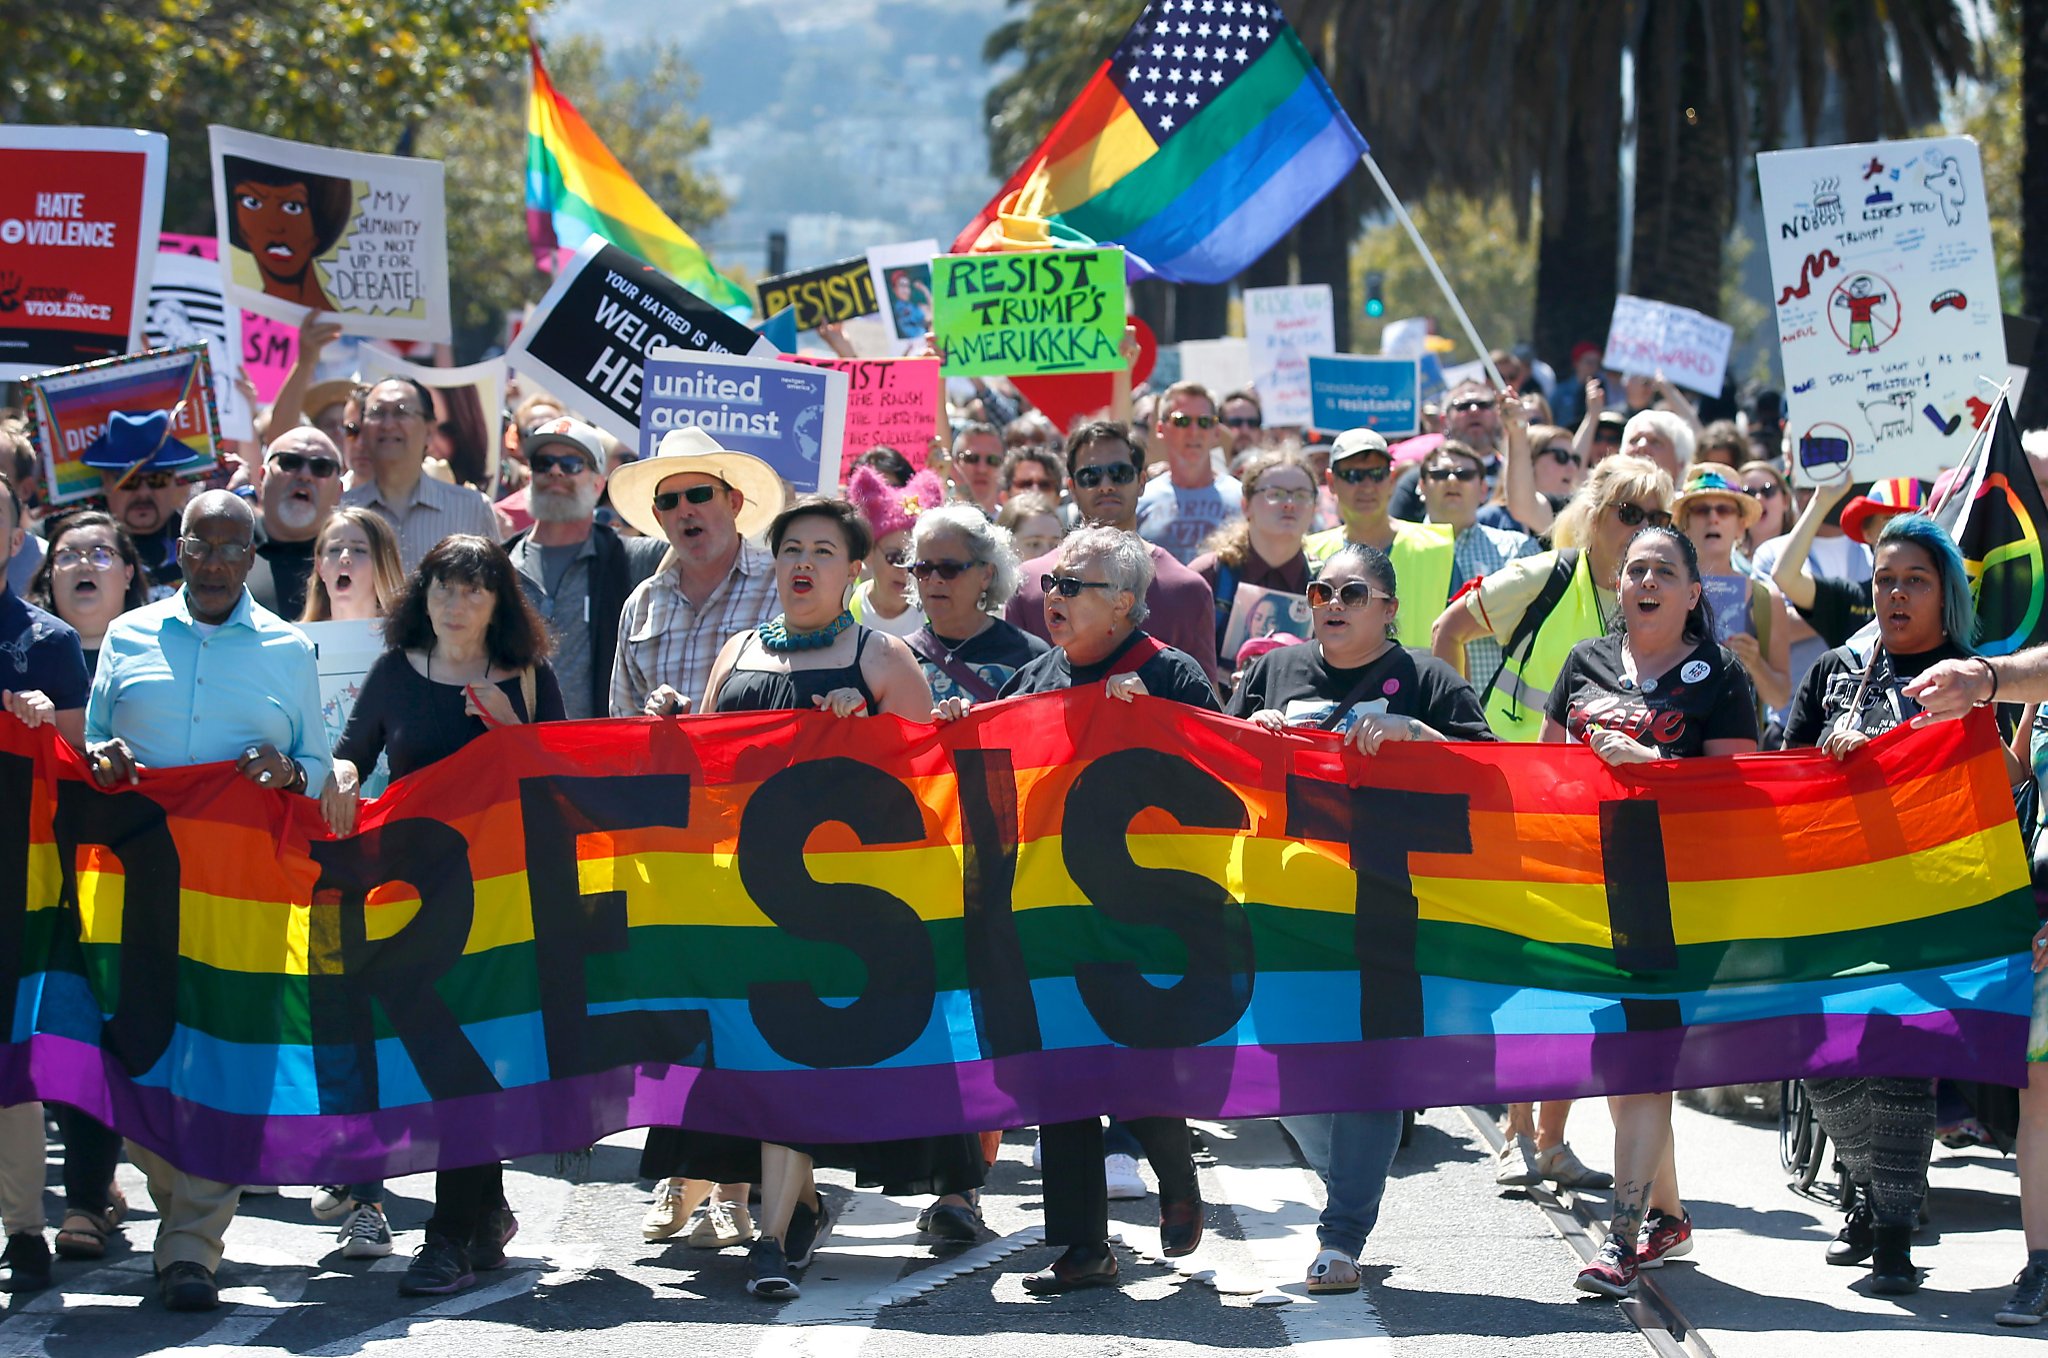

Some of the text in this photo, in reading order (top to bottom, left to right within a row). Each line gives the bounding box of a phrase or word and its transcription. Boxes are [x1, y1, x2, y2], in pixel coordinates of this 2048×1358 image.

[36, 192, 85, 219] HATE
[373, 189, 411, 213] MY
[25, 220, 116, 248] VIOLENCE
[358, 217, 421, 236] HUMANITY
[1781, 210, 1847, 241] NOBODY
[1909, 199, 1937, 214] YOU
[349, 254, 412, 269] UP FOR
[358, 239, 415, 253] IS NOT
[337, 269, 421, 301] DEBATE!
[948, 253, 1098, 297] RESIST
[25, 300, 113, 321] VIOLENCE
[604, 269, 640, 300] YOUR
[639, 294, 692, 336] HATRED
[691, 330, 708, 347] IS
[765, 263, 879, 331] RESIST!
[972, 285, 1106, 326] TRUMP'S
[594, 294, 683, 360] WELC
[939, 326, 1117, 367] AMERIKKKA
[585, 345, 645, 417] HE
[653, 370, 762, 402] united
[650, 404, 780, 436] against
[1696, 662, 1708, 672] NO
[1864, 726, 1879, 735] SAN
[309, 747, 1683, 1113] RESIST!
